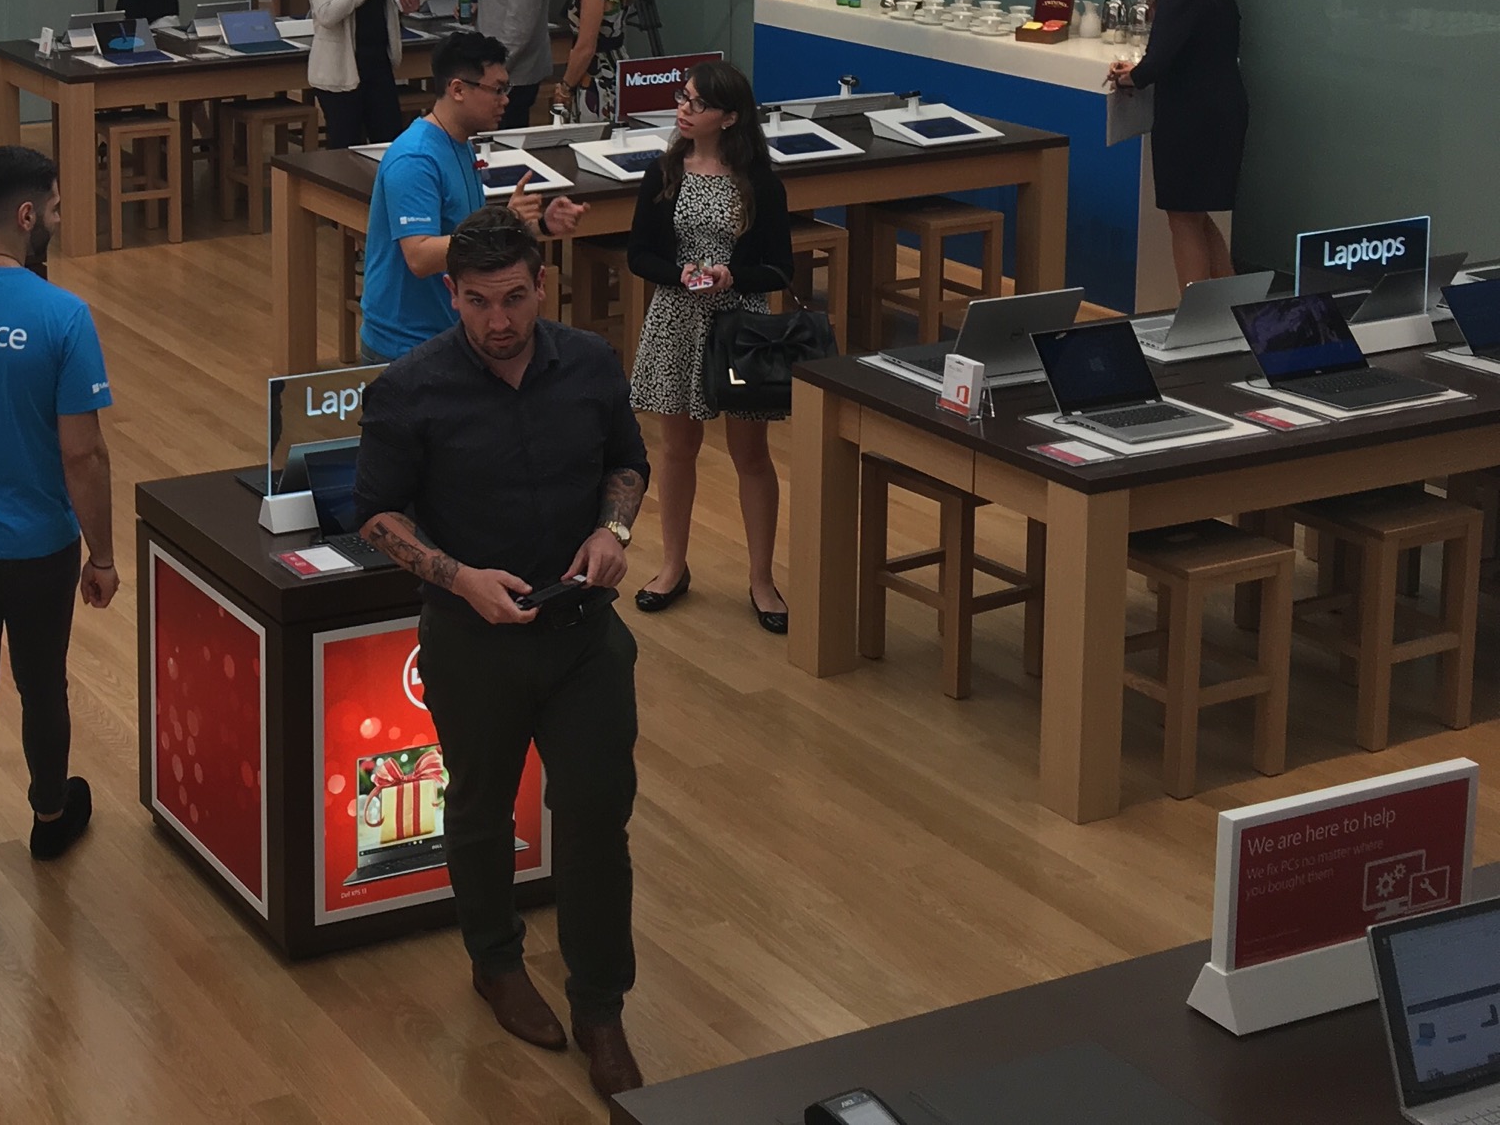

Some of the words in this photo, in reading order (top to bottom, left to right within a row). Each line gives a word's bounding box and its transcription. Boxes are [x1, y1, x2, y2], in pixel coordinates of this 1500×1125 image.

[626, 68, 681, 87] Microsoft
[1323, 236, 1406, 271] Laptops
[1247, 836, 1274, 856] We
[1277, 832, 1302, 850] are
[1305, 822, 1340, 843] here
[1343, 817, 1360, 834] to
[1363, 807, 1397, 829] help
[1246, 865, 1265, 880] We
[1266, 861, 1279, 876] fix
[1281, 857, 1300, 873] PCs
[1301, 854, 1316, 867] no
[1317, 846, 1351, 863] matter
[1353, 838, 1384, 856] where
[1245, 882, 1266, 901] you
[1267, 874, 1306, 893] bought
[1307, 867, 1334, 884] them
